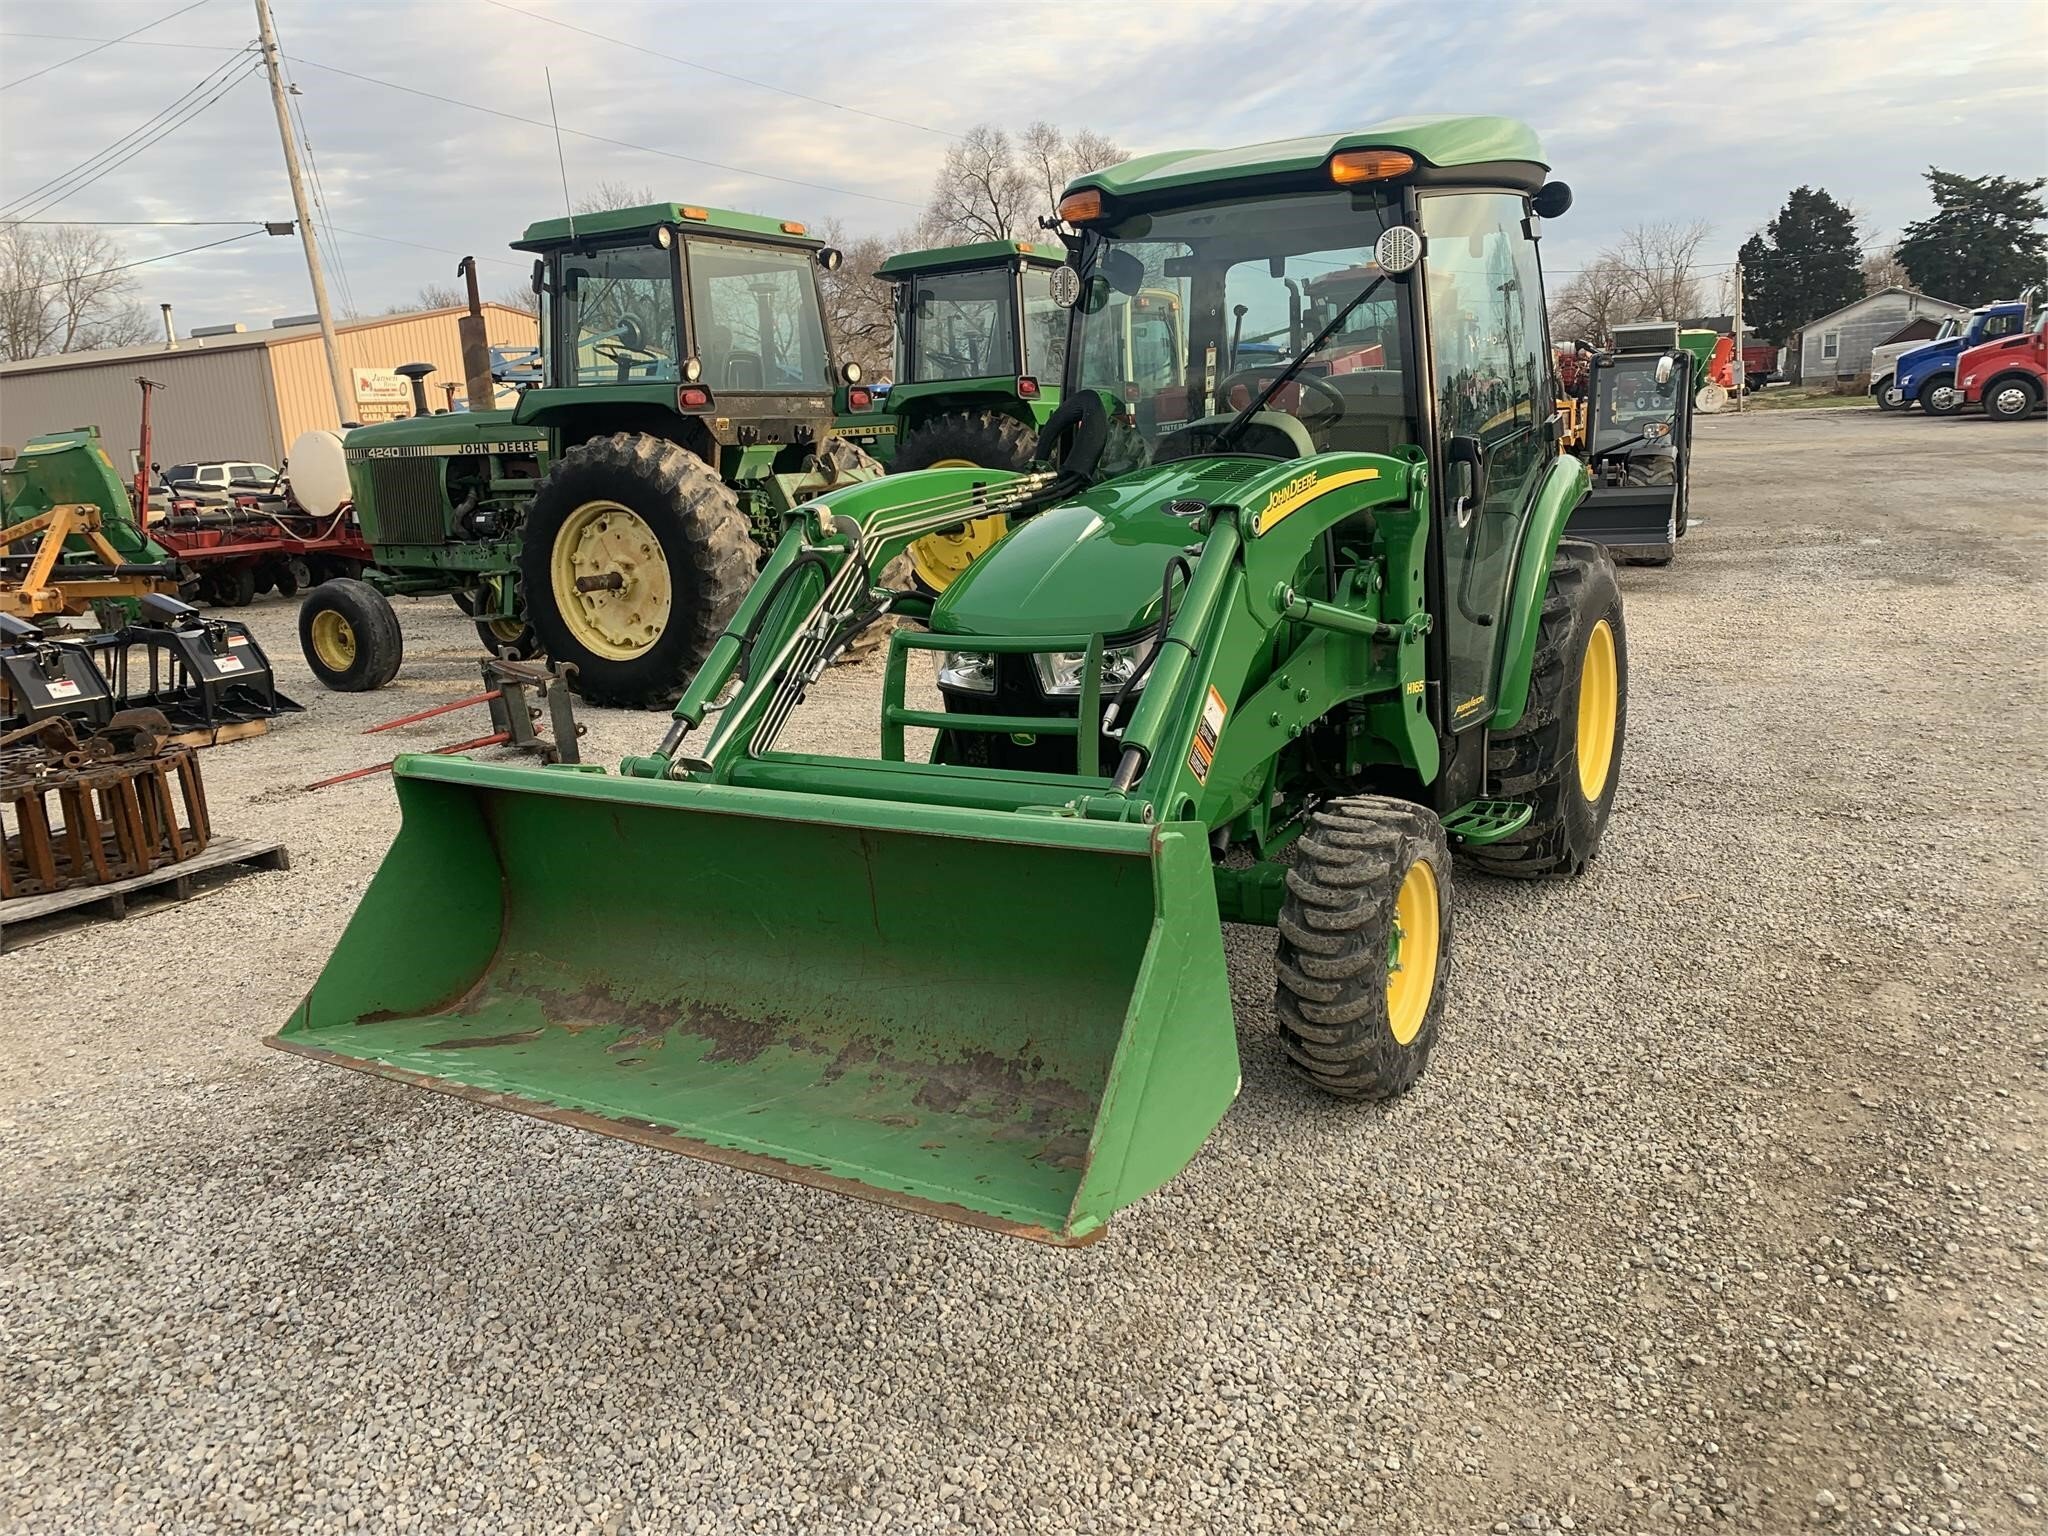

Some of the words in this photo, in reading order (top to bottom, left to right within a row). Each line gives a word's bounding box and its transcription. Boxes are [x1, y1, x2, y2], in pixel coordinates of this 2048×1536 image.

[836, 428, 860, 436] JOHN
[368, 448, 400, 458] 4240
[458, 443, 490, 454] JOHN
[498, 441, 539, 452] DEERE
[1266, 485, 1291, 512] JOHN
[1289, 470, 1318, 498] DEERE
[1406, 680, 1425, 695] H165
